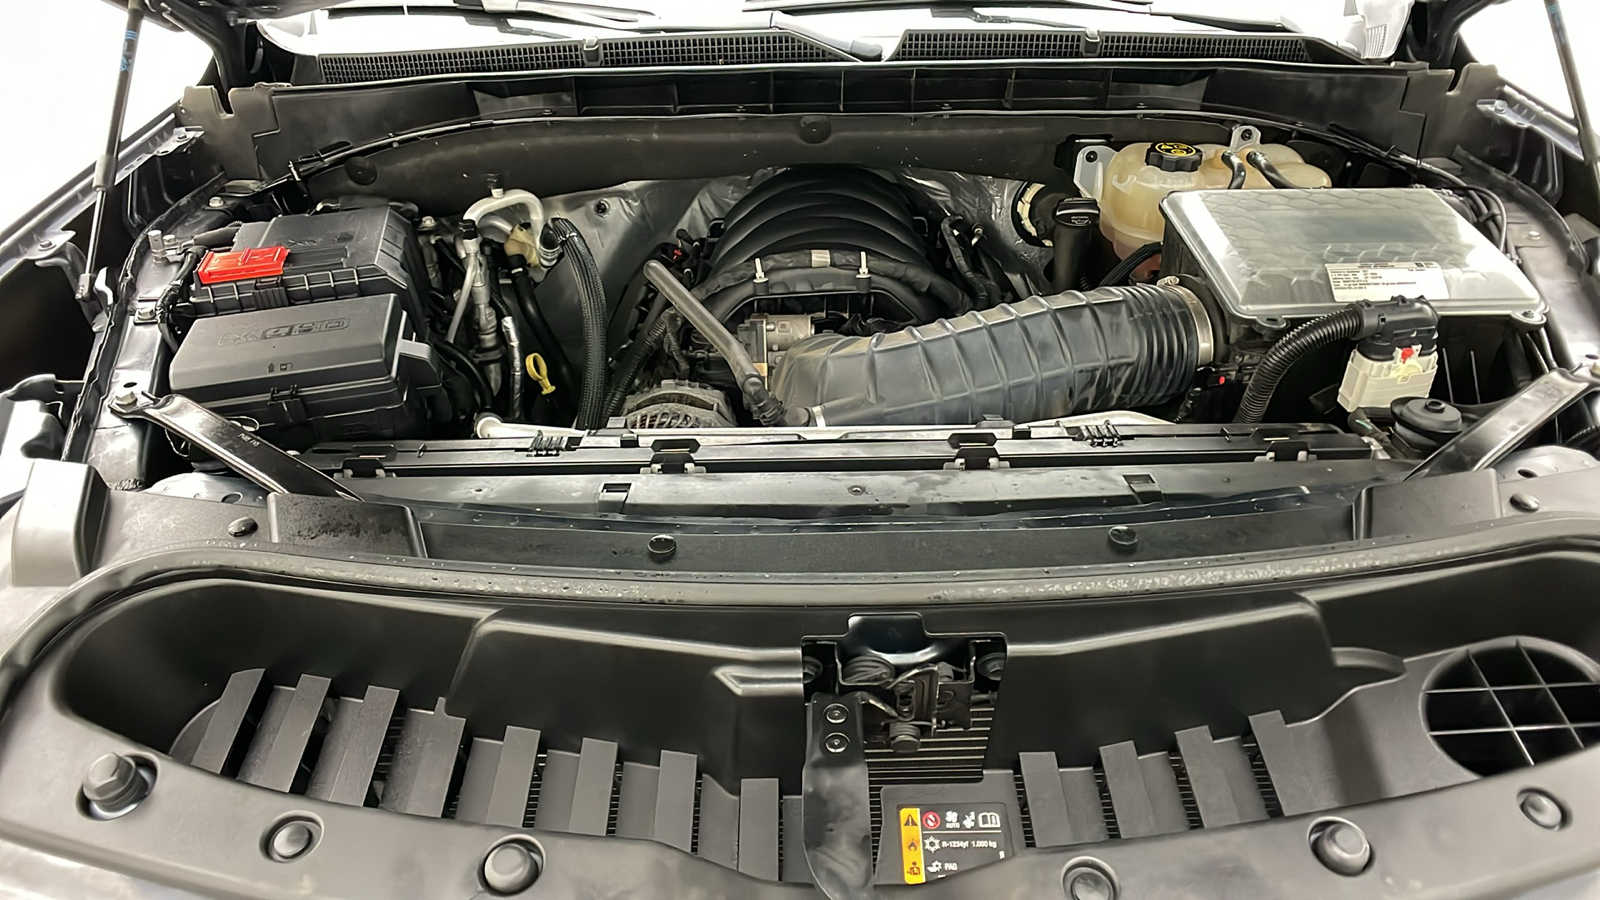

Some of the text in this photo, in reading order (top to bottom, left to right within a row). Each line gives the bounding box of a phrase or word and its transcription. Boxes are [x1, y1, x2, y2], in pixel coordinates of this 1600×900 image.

[941, 841, 969, 849] R-1234yf
[989, 840, 997, 849] kg
[944, 862, 958, 871] PAG
